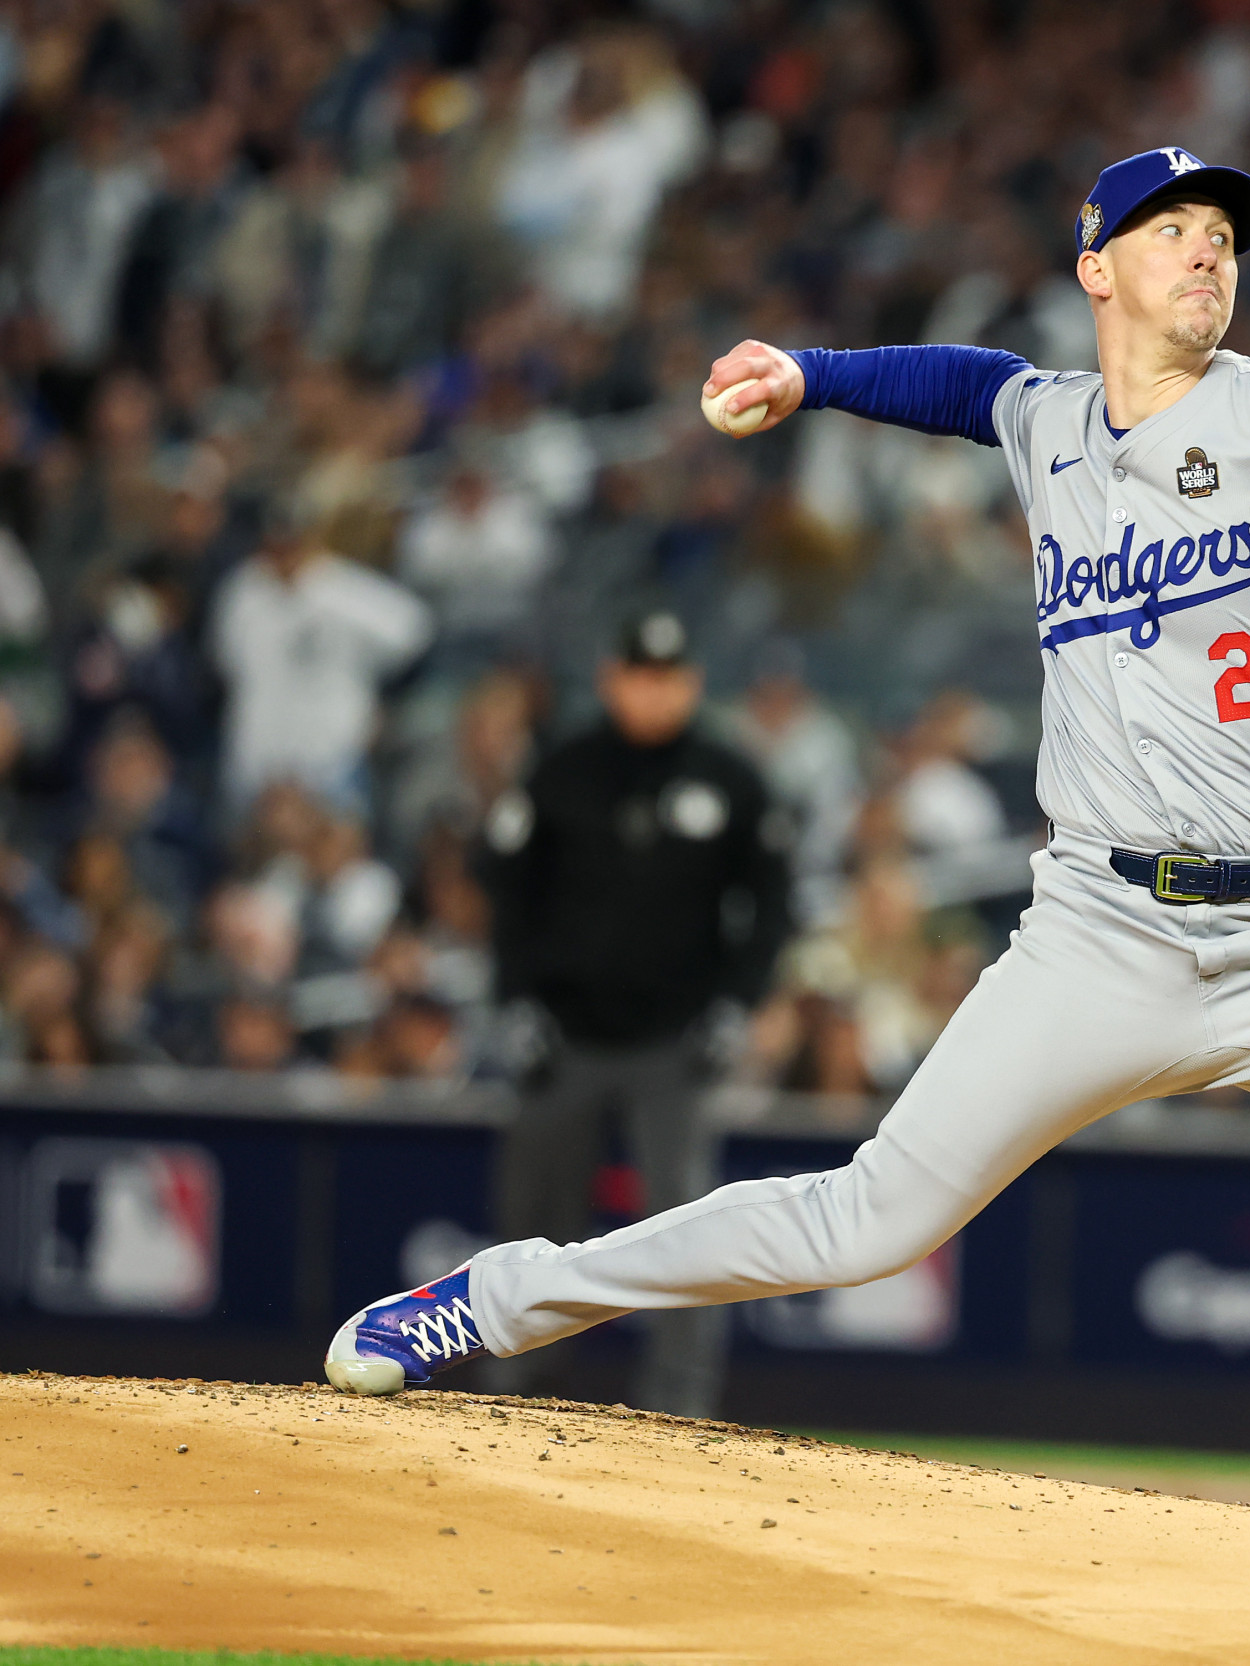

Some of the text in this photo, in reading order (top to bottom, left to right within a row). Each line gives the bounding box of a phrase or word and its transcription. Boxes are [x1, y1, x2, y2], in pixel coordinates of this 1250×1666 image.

[1160, 148, 1201, 176] LA
[1179, 467, 1216, 481] WORLD
[1181, 476, 1216, 489] SERIES
